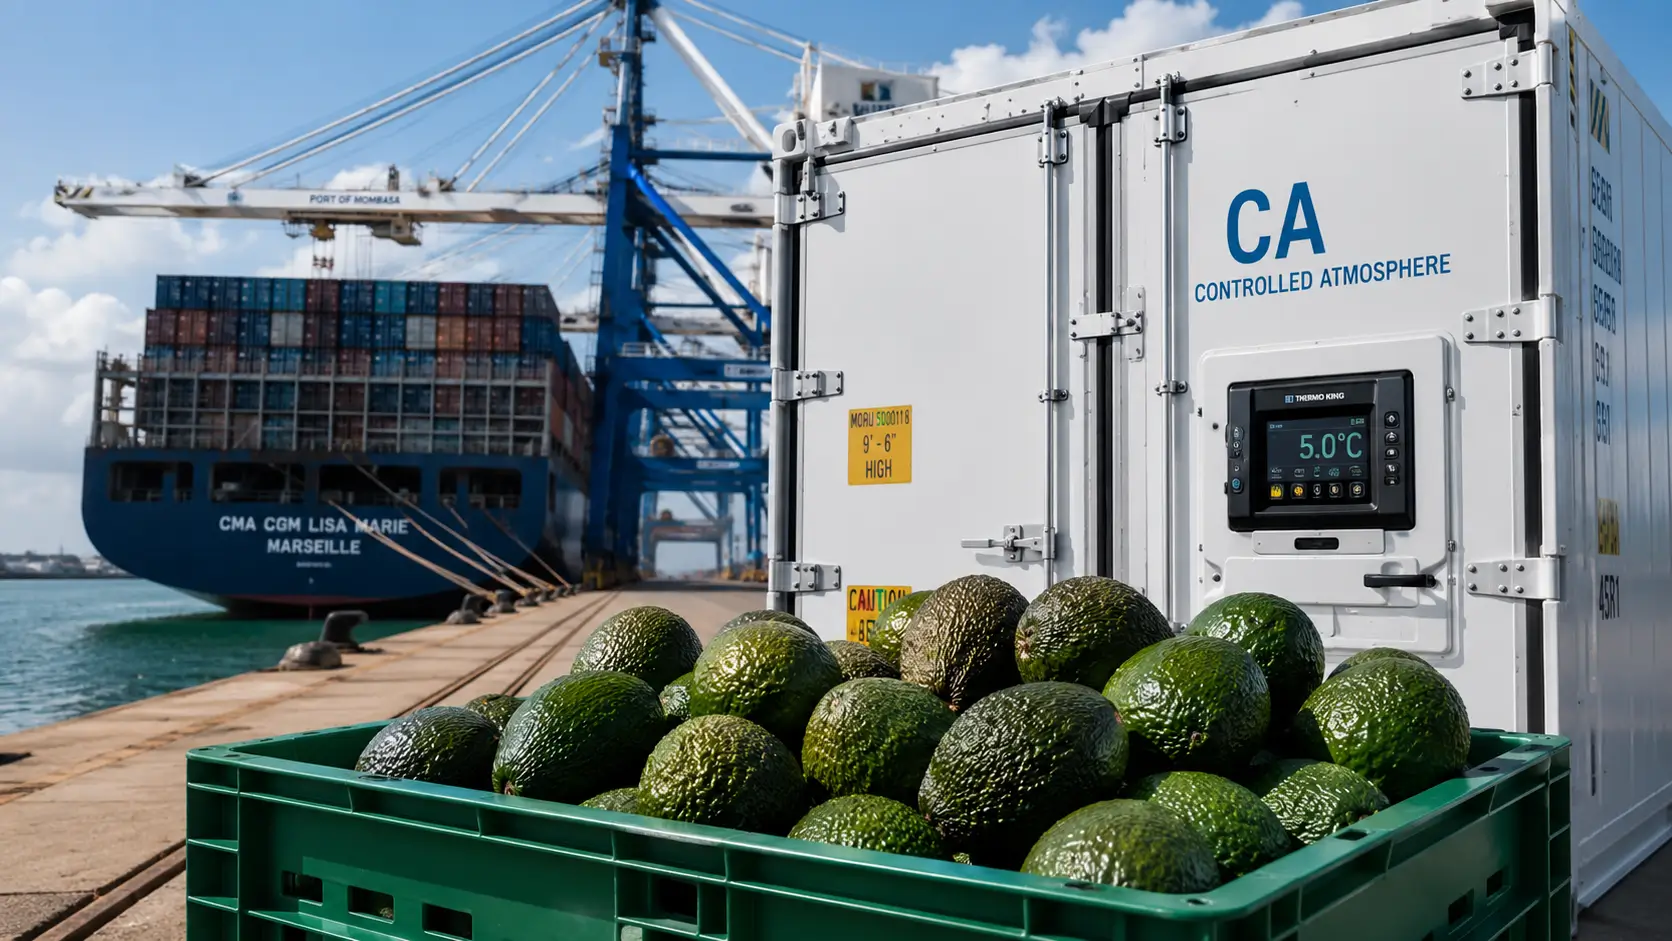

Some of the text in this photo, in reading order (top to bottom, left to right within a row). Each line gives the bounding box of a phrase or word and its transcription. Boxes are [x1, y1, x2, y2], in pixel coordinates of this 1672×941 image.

[310, 194, 400, 204] PORT OF MOMBASA
[1226, 181, 1326, 265] CA
[1194, 253, 1451, 303] CONTROLLED ATMOSPHERE
[1295, 392, 1345, 402] THERMO KING
[1299, 432, 1363, 460] 5.0°C
[865, 459, 892, 479] HIGH
[219, 516, 409, 534] CMA CGM LISA MARIE
[267, 539, 361, 555] MARSEILLE
[1599, 574, 1620, 621] 45R1
